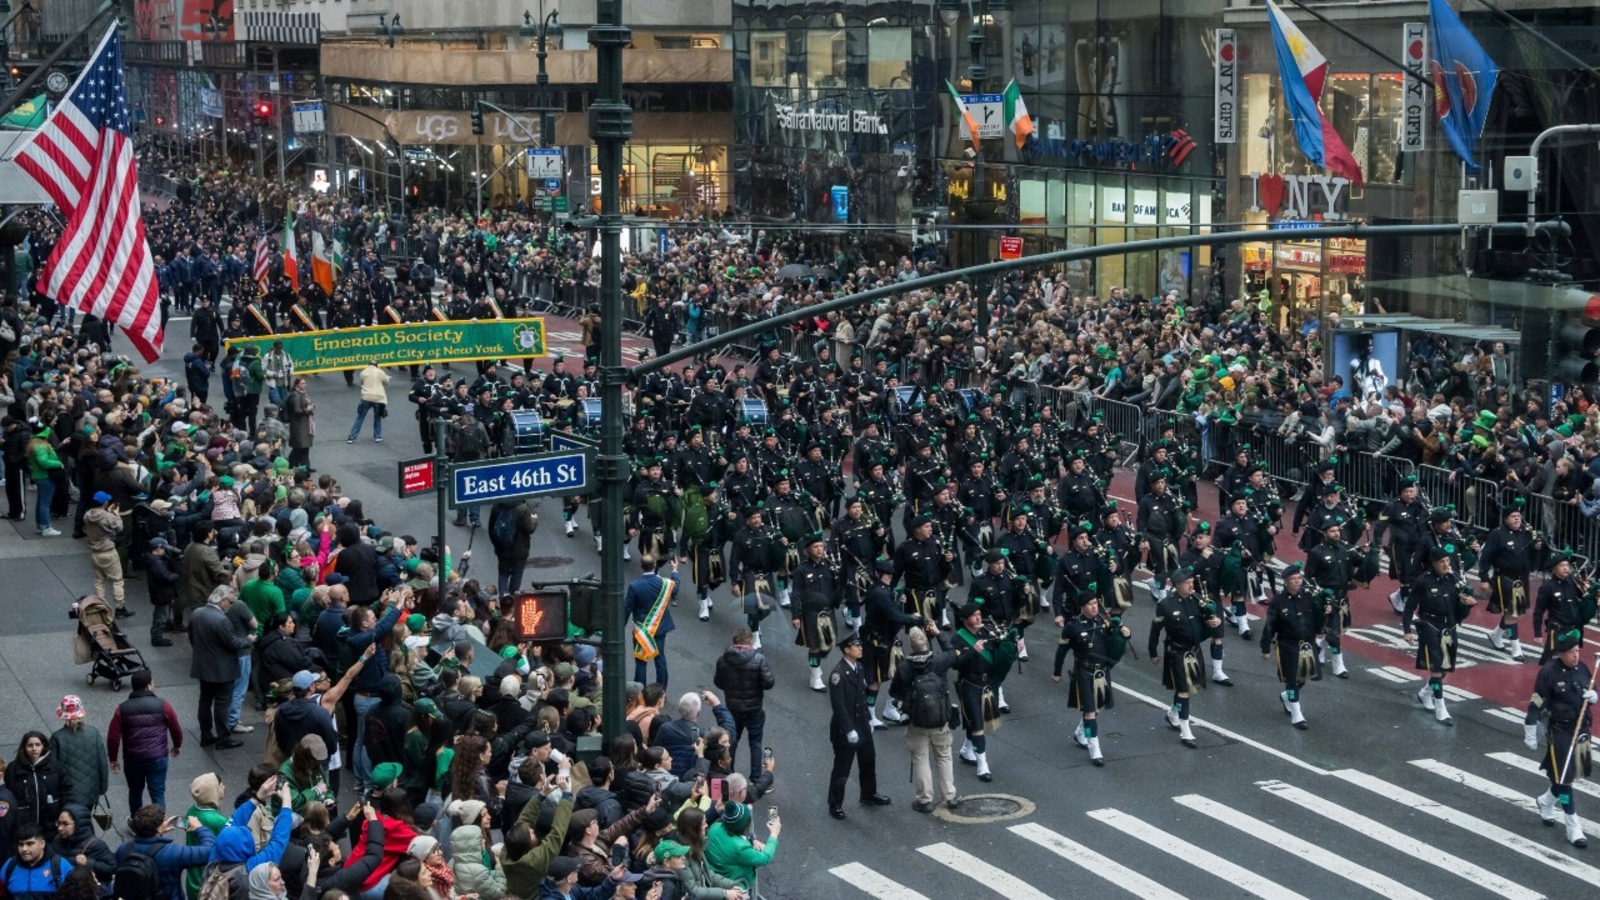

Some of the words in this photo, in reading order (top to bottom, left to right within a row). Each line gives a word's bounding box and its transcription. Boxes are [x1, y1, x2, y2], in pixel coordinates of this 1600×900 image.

[1220, 33, 1234, 43] I
[1408, 28, 1423, 38] I
[1219, 62, 1234, 97] NY
[415, 114, 458, 142] UGG
[776, 105, 807, 130] Safra
[808, 108, 849, 132] National
[853, 110, 882, 134] Bank
[1219, 102, 1233, 139] GIFTS
[1407, 105, 1421, 146] GIFTS
[1250, 171, 1260, 213] I
[1133, 204, 1143, 214] OF
[313, 331, 391, 351] Emerald
[394, 328, 464, 344] Society
[316, 350, 394, 367] Department
[396, 347, 424, 361] City
[427, 348, 441, 358] of
[443, 345, 473, 355] New
[474, 343, 504, 354] York
[463, 474, 506, 496] East
[510, 466, 552, 489] 46th
[556, 463, 577, 483] St
